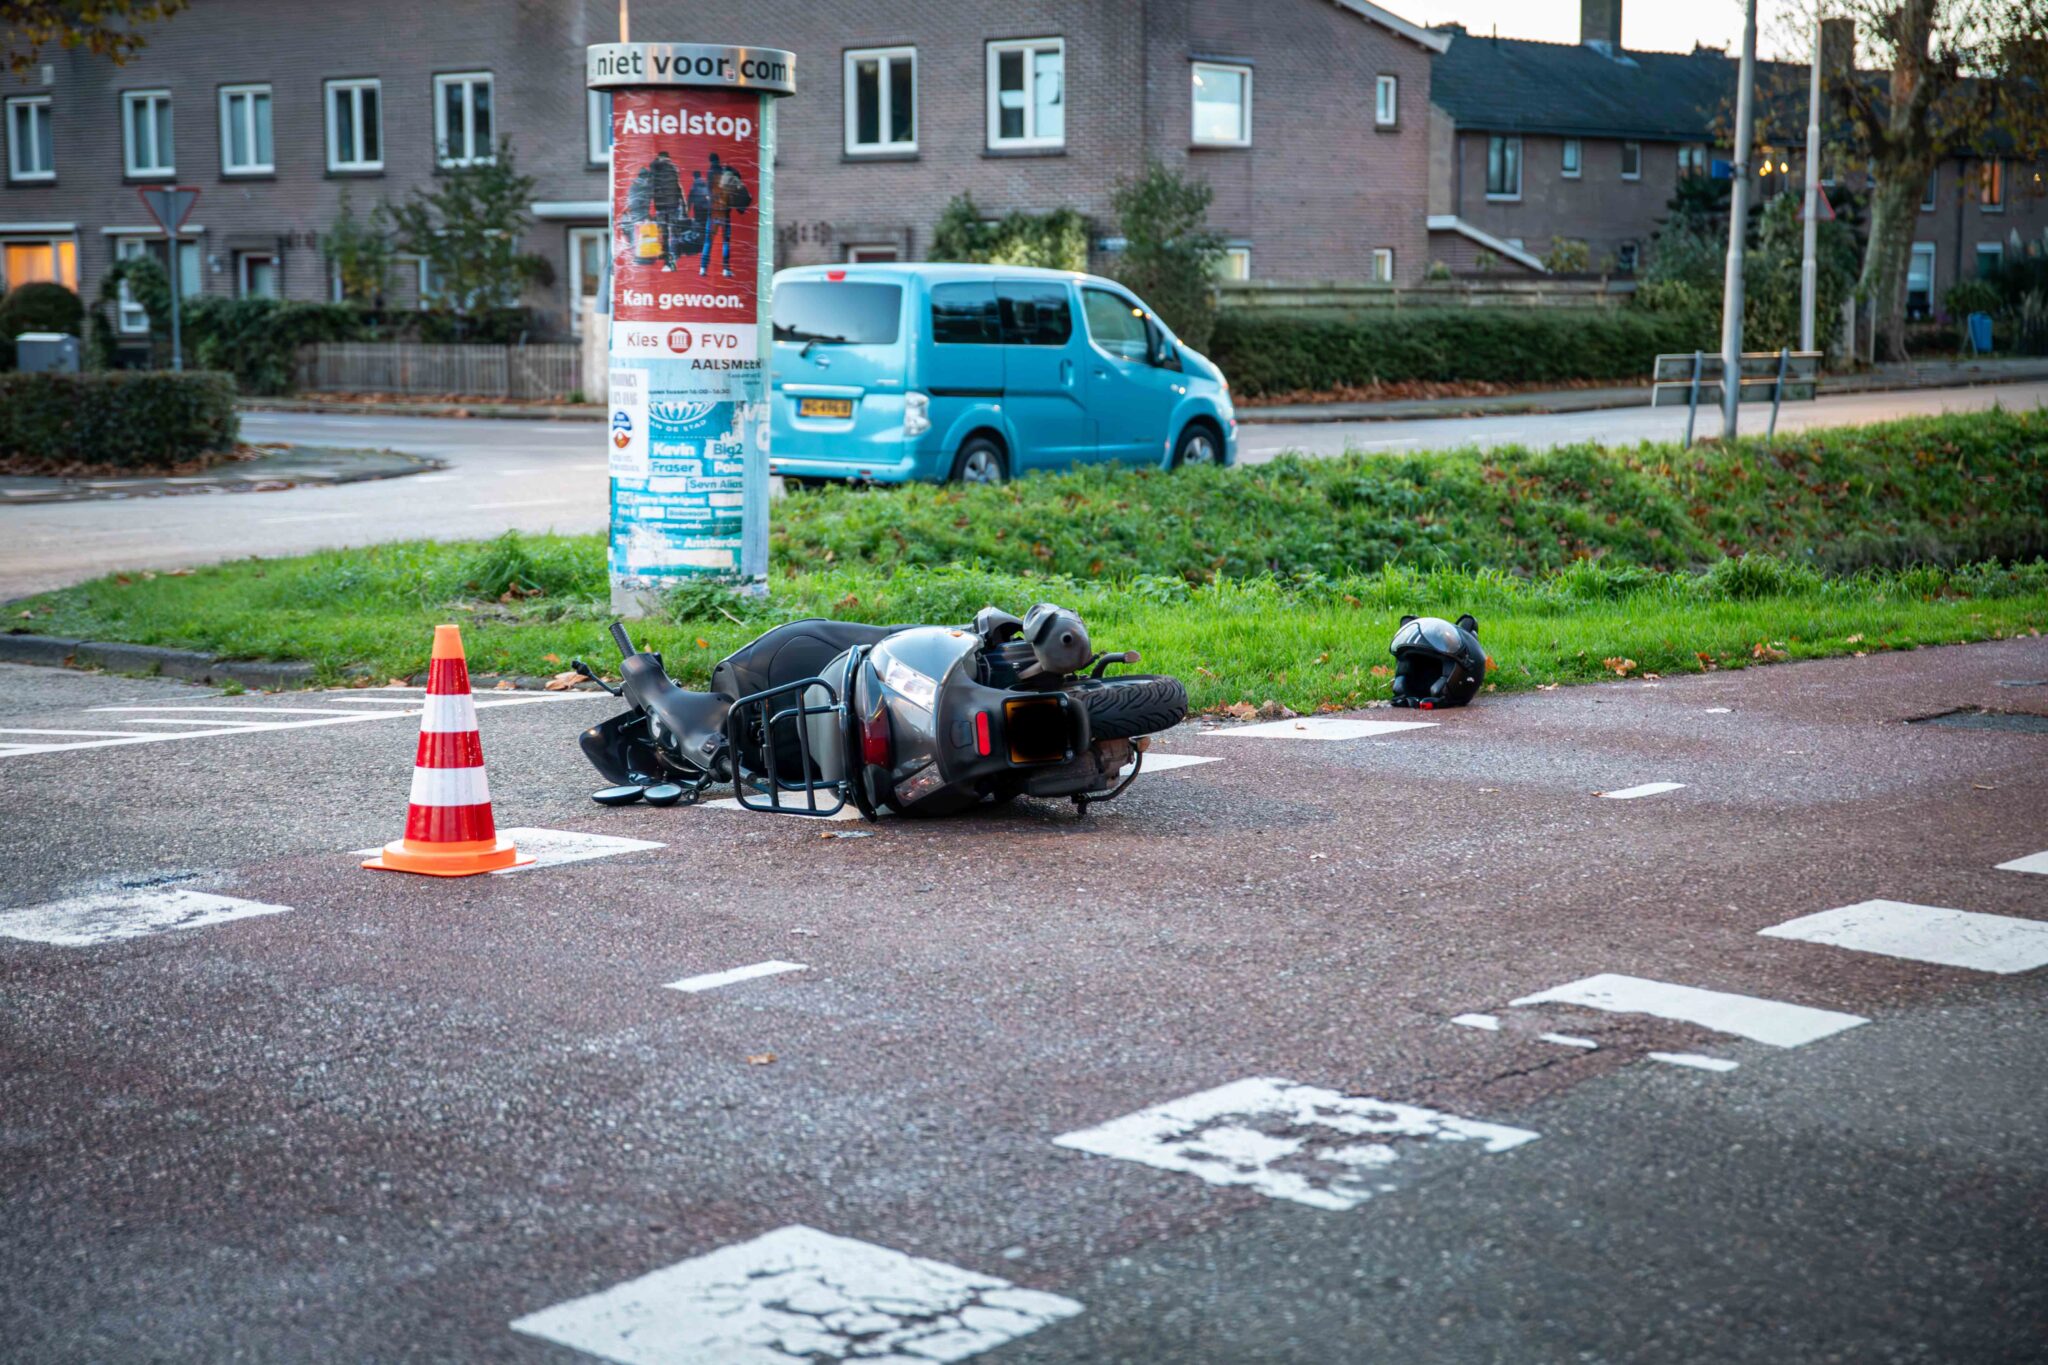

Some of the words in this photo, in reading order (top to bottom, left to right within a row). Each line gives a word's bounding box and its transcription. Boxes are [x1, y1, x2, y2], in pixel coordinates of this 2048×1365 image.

[597, 50, 643, 75] niet
[653, 55, 730, 76] voor
[622, 109, 751, 142] Asielstop
[623, 289, 654, 307] Kan
[658, 292, 745, 310] gewoon.
[627, 332, 659, 347] Kies
[701, 334, 738, 349] FVD
[652, 442, 695, 456] Kevin
[713, 442, 743, 457] Big2
[651, 461, 695, 472] Fraser
